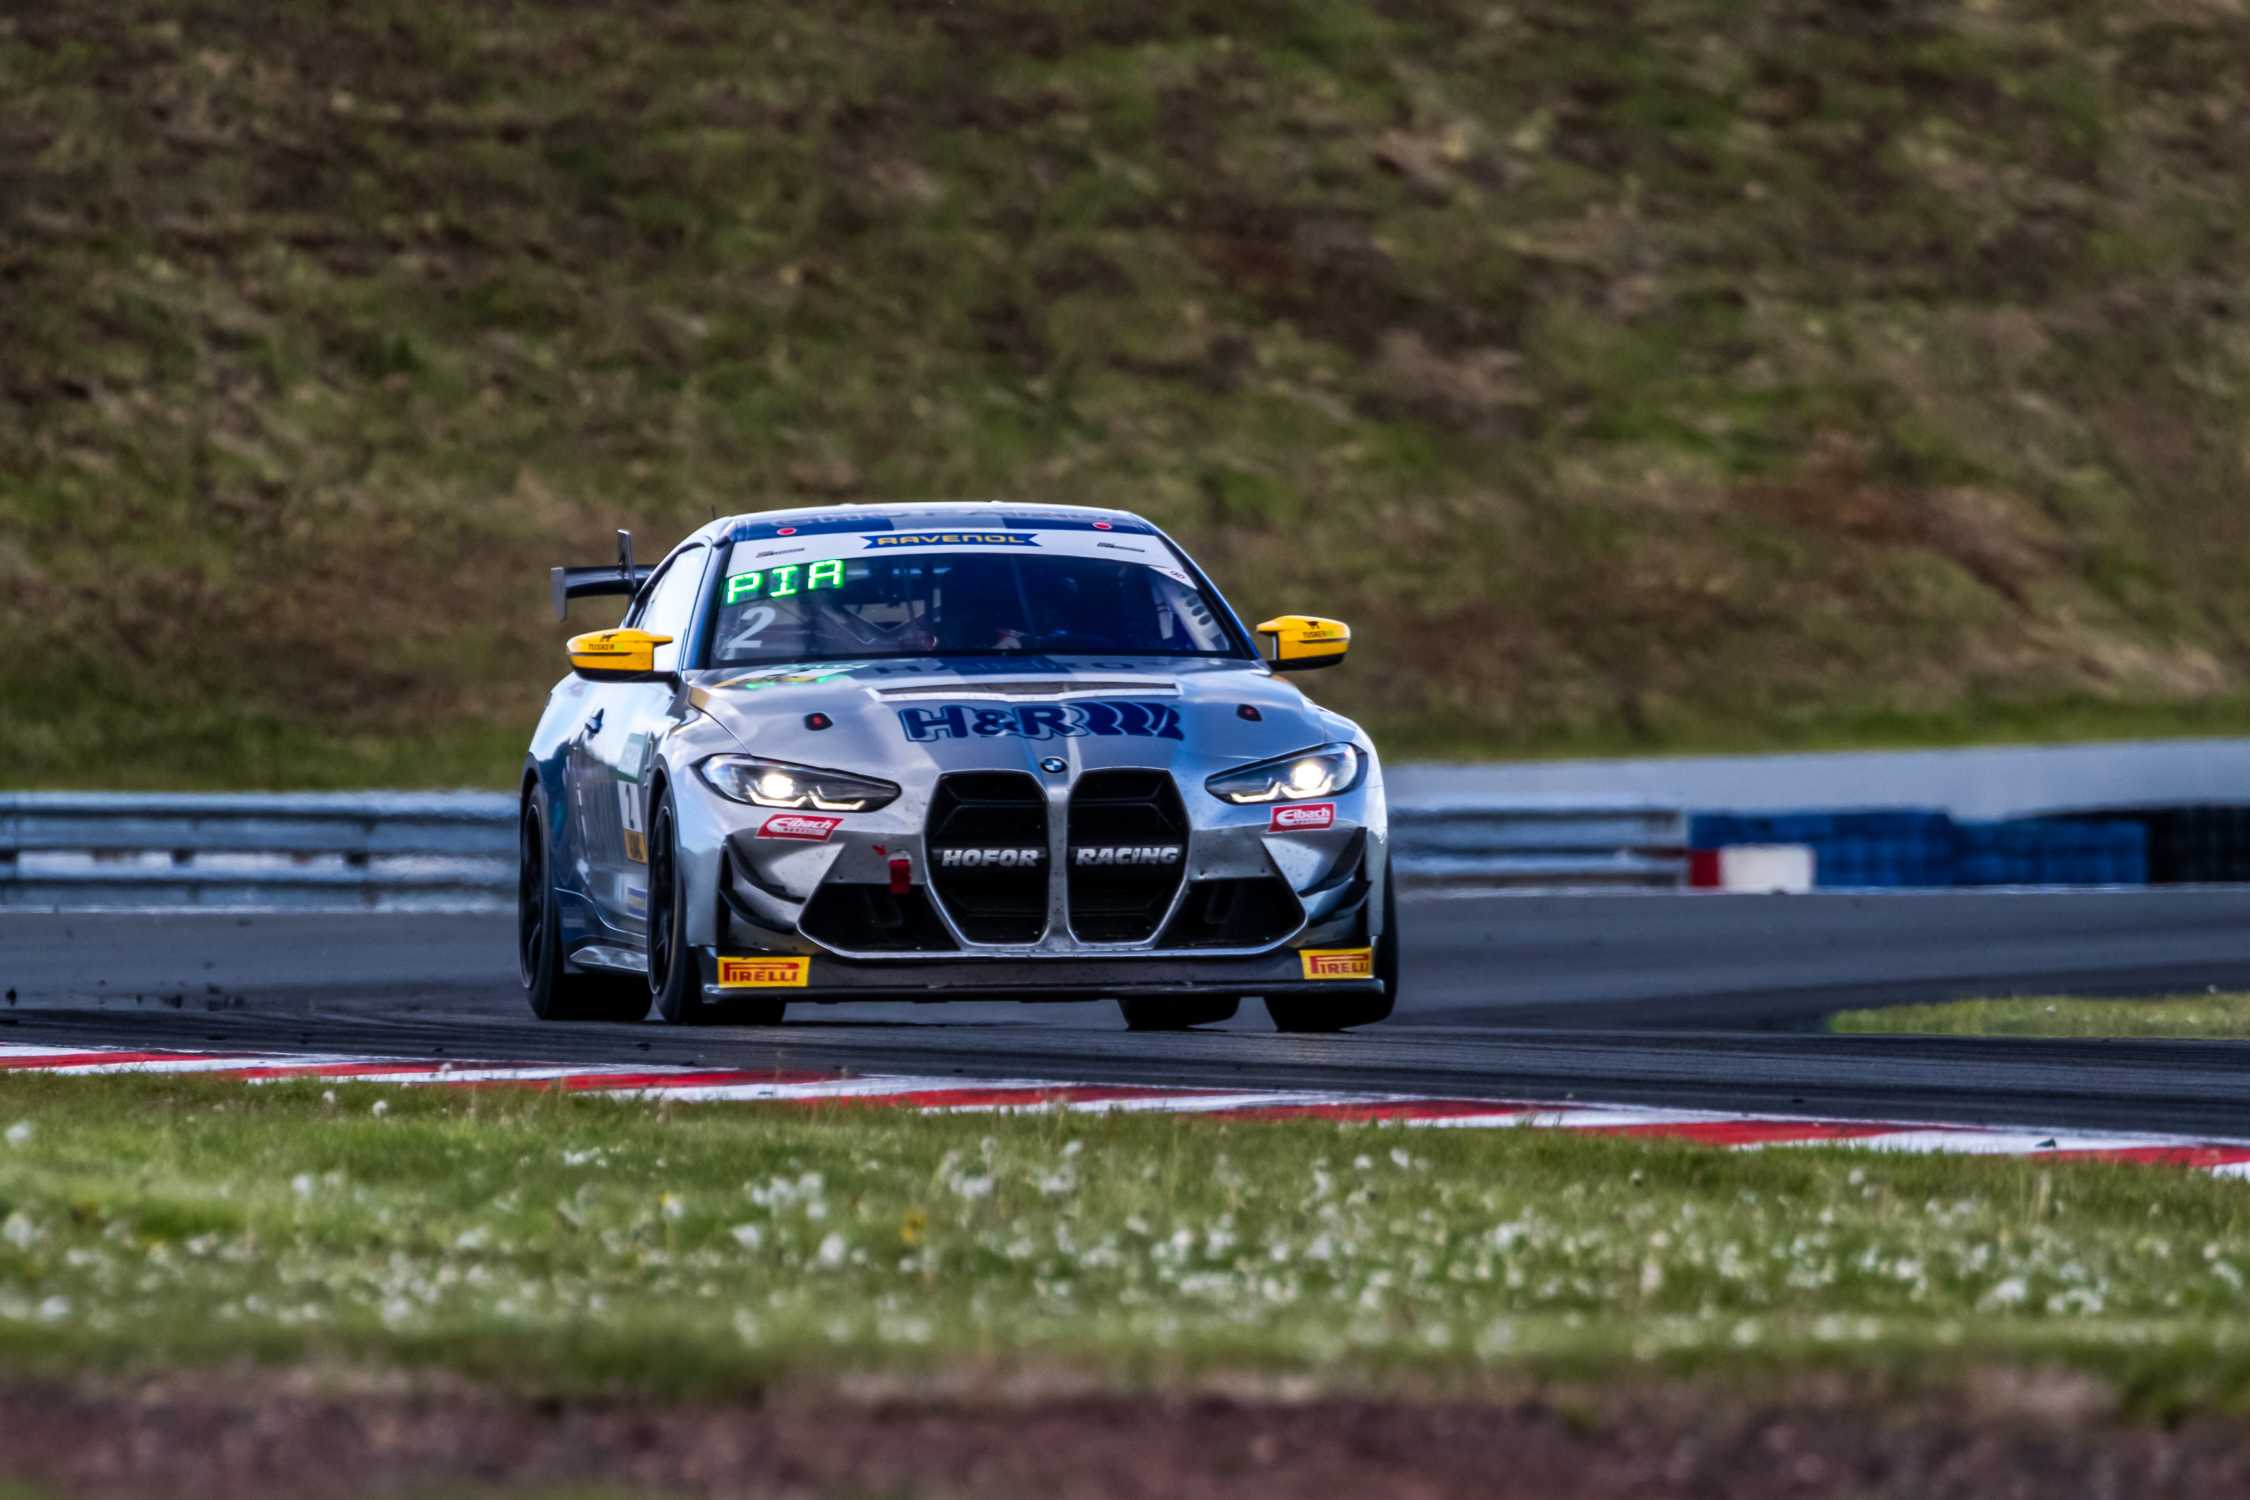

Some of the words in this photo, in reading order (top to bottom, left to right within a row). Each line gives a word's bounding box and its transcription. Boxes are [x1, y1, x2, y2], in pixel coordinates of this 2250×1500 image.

[877, 534, 1026, 547] RAVENOL
[727, 558, 845, 605] PIA
[722, 605, 776, 649] 2
[898, 703, 1090, 743] H&R
[941, 849, 1040, 867] HOFOR
[1075, 847, 1180, 865] RACING
[723, 962, 800, 982] PIRELLI
[1309, 953, 1370, 974] PIRELLI
